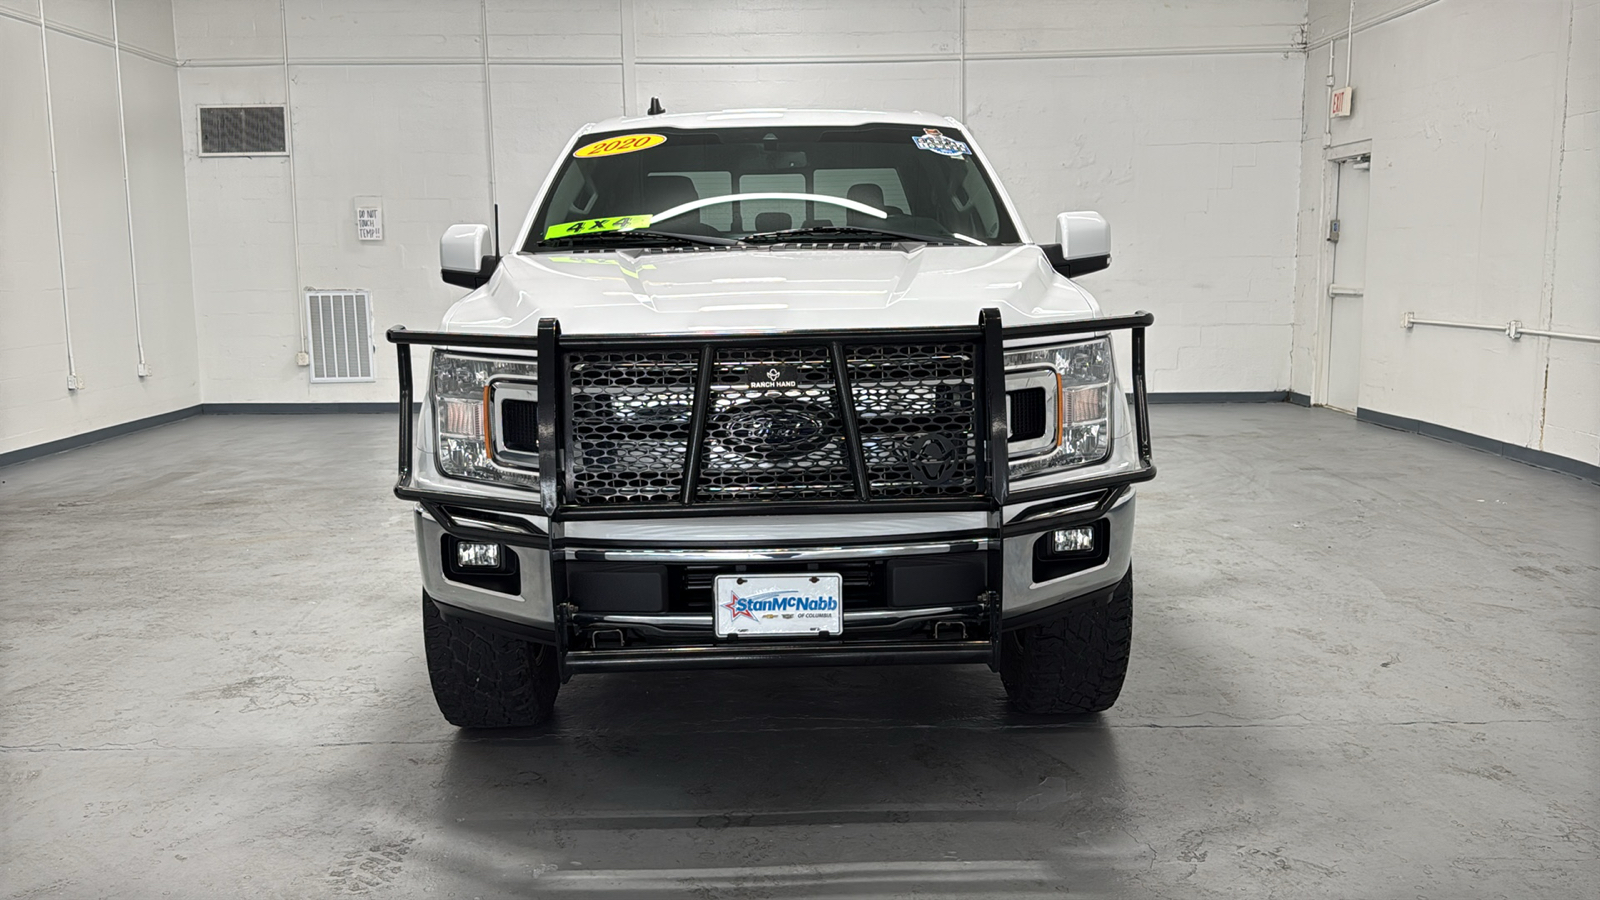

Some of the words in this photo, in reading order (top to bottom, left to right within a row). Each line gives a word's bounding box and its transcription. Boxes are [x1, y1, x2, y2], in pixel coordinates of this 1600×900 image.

[1332, 92, 1345, 114] EXIT
[587, 136, 652, 156] 2020
[358, 209, 366, 219] DO
[366, 209, 378, 219] NOT
[358, 219, 375, 228] TOUCH
[735, 596, 838, 613] StanMcNabb
